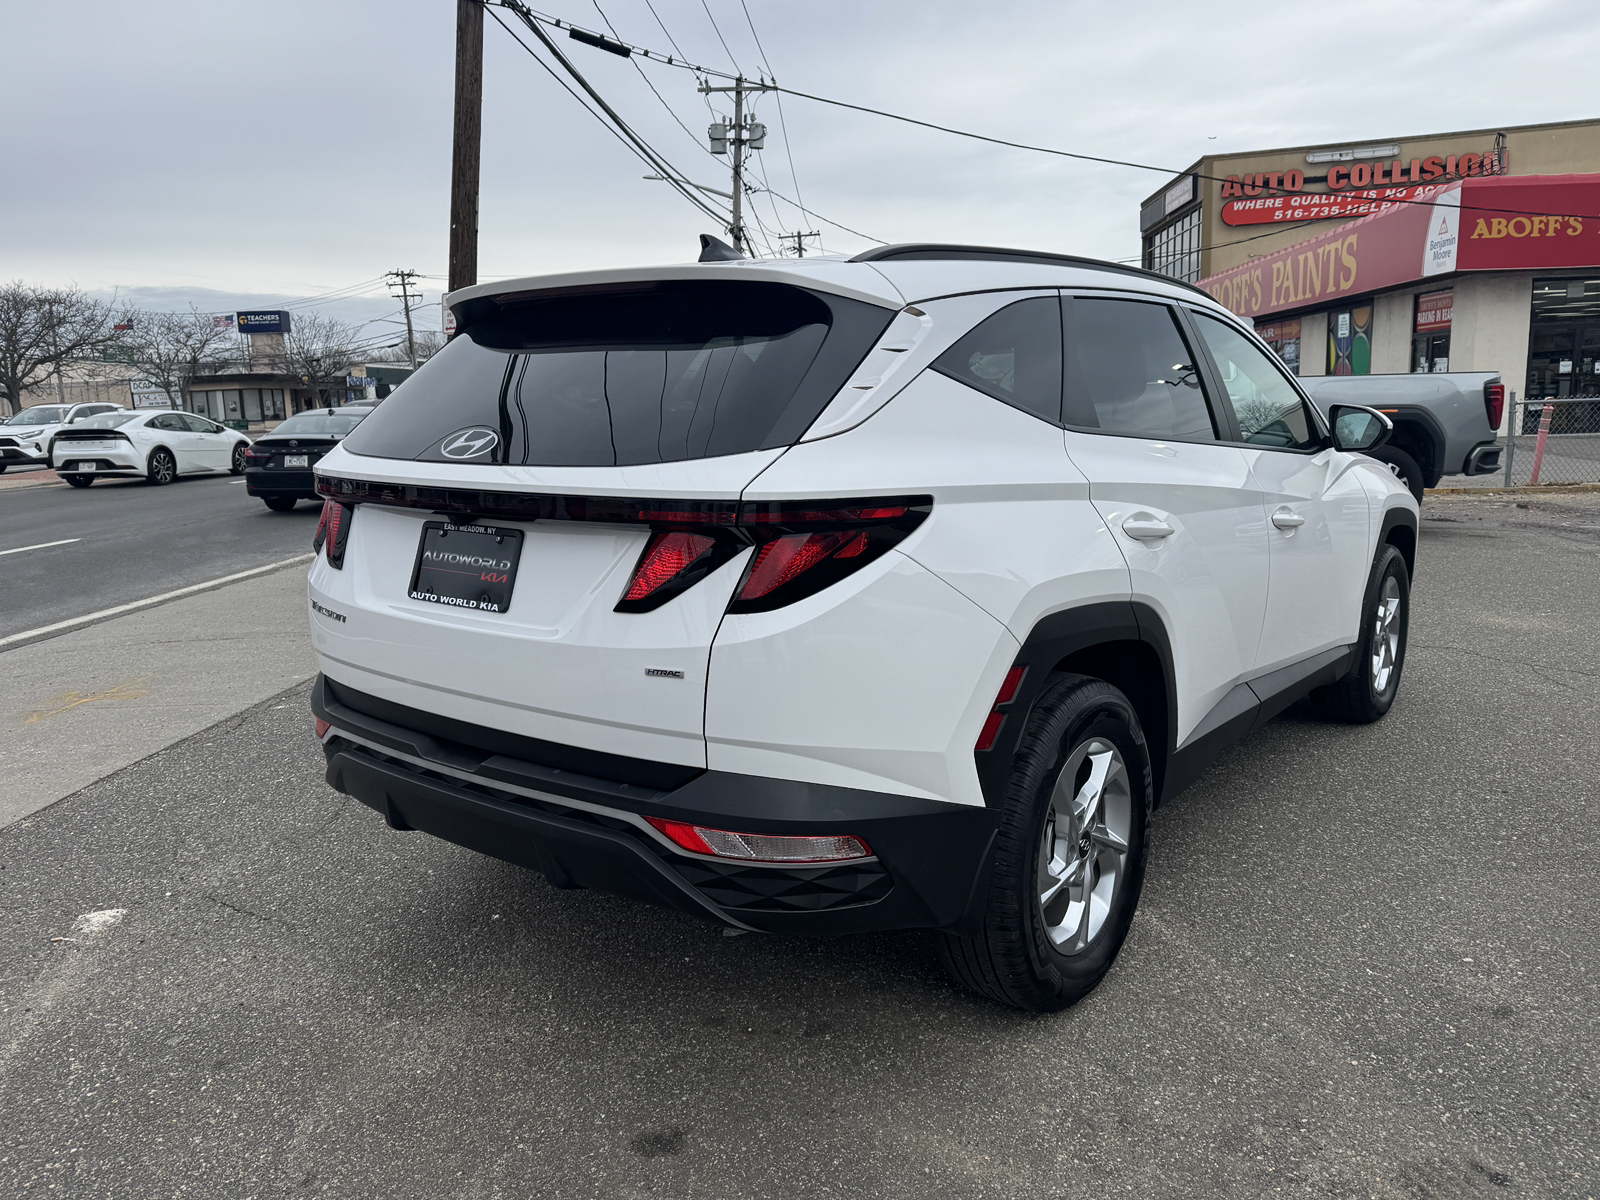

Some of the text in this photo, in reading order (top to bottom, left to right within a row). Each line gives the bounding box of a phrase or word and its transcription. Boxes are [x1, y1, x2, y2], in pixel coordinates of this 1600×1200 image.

[1221, 169, 1304, 198] AUTO
[1233, 198, 1283, 211] WHERE
[1291, 192, 1355, 206] QUALITY
[1362, 189, 1377, 198] IS
[1385, 186, 1406, 199] NO
[1470, 214, 1583, 239] ABOFF'S
[1430, 234, 1456, 251] Benjamin
[1433, 249, 1451, 261] Moore
[1270, 233, 1358, 307] PAINTS
[444, 523, 458, 531] EAST
[487, 527, 497, 535] NY
[423, 549, 511, 571] AUTOWORLD
[411, 591, 499, 612] AUTO WORLD KIA
[647, 668, 681, 678] HTRAC
